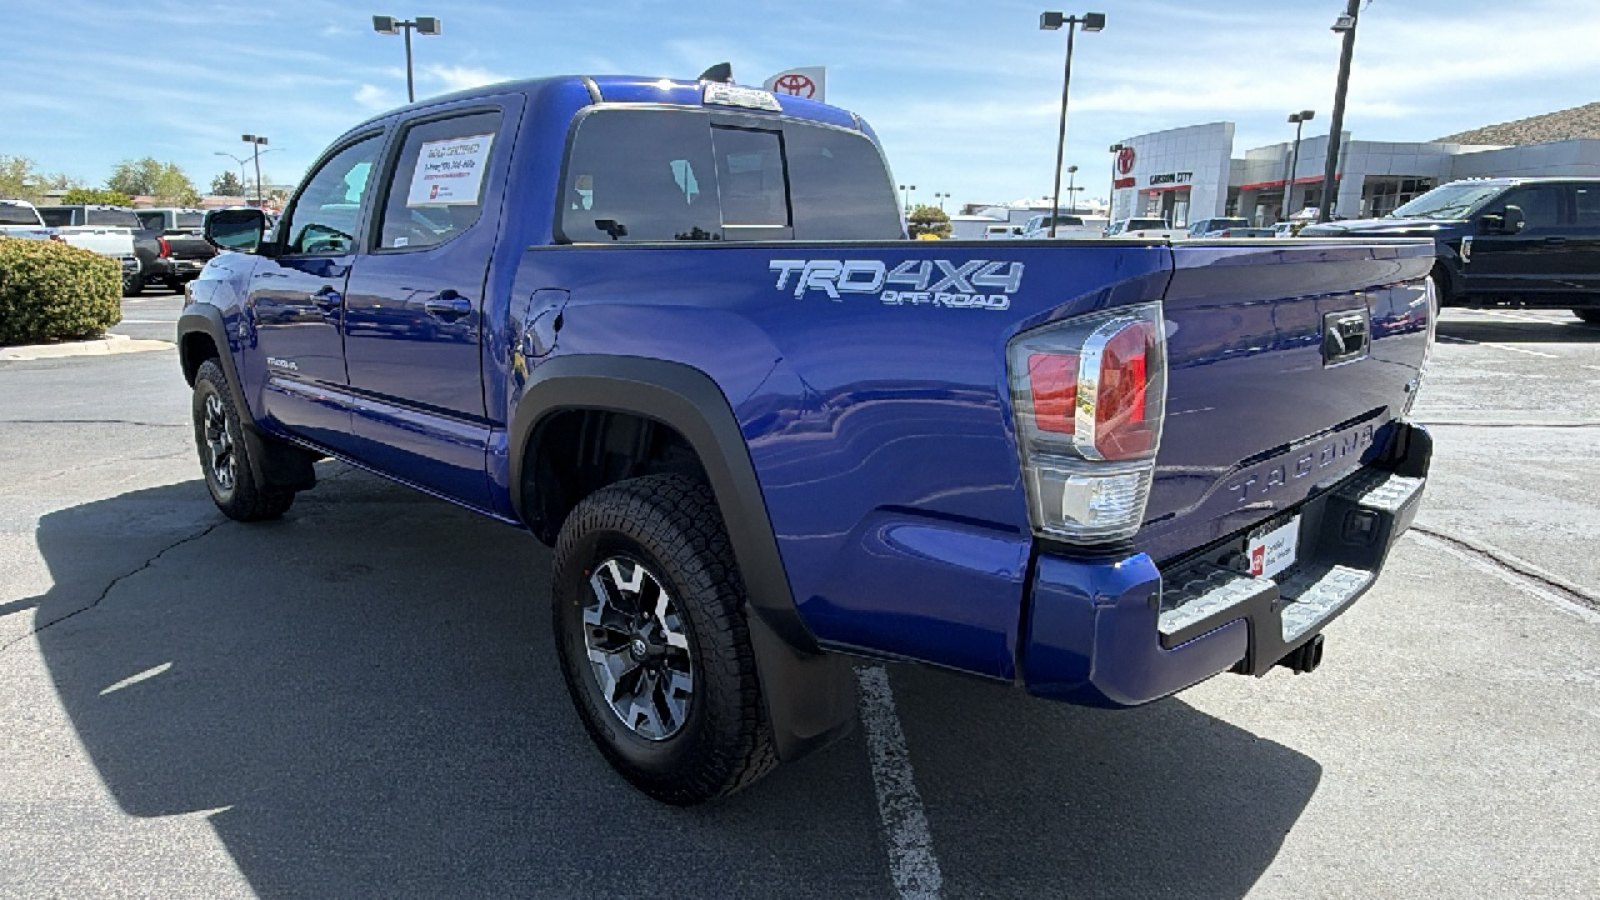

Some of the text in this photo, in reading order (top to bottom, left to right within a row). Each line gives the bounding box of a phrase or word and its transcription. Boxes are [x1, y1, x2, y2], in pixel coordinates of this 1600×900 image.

[1150, 172, 1193, 185] CARSON CITY
[768, 259, 886, 302] TRD
[880, 290, 1010, 310] OFF ROAD
[1228, 424, 1374, 503] TACOMA
